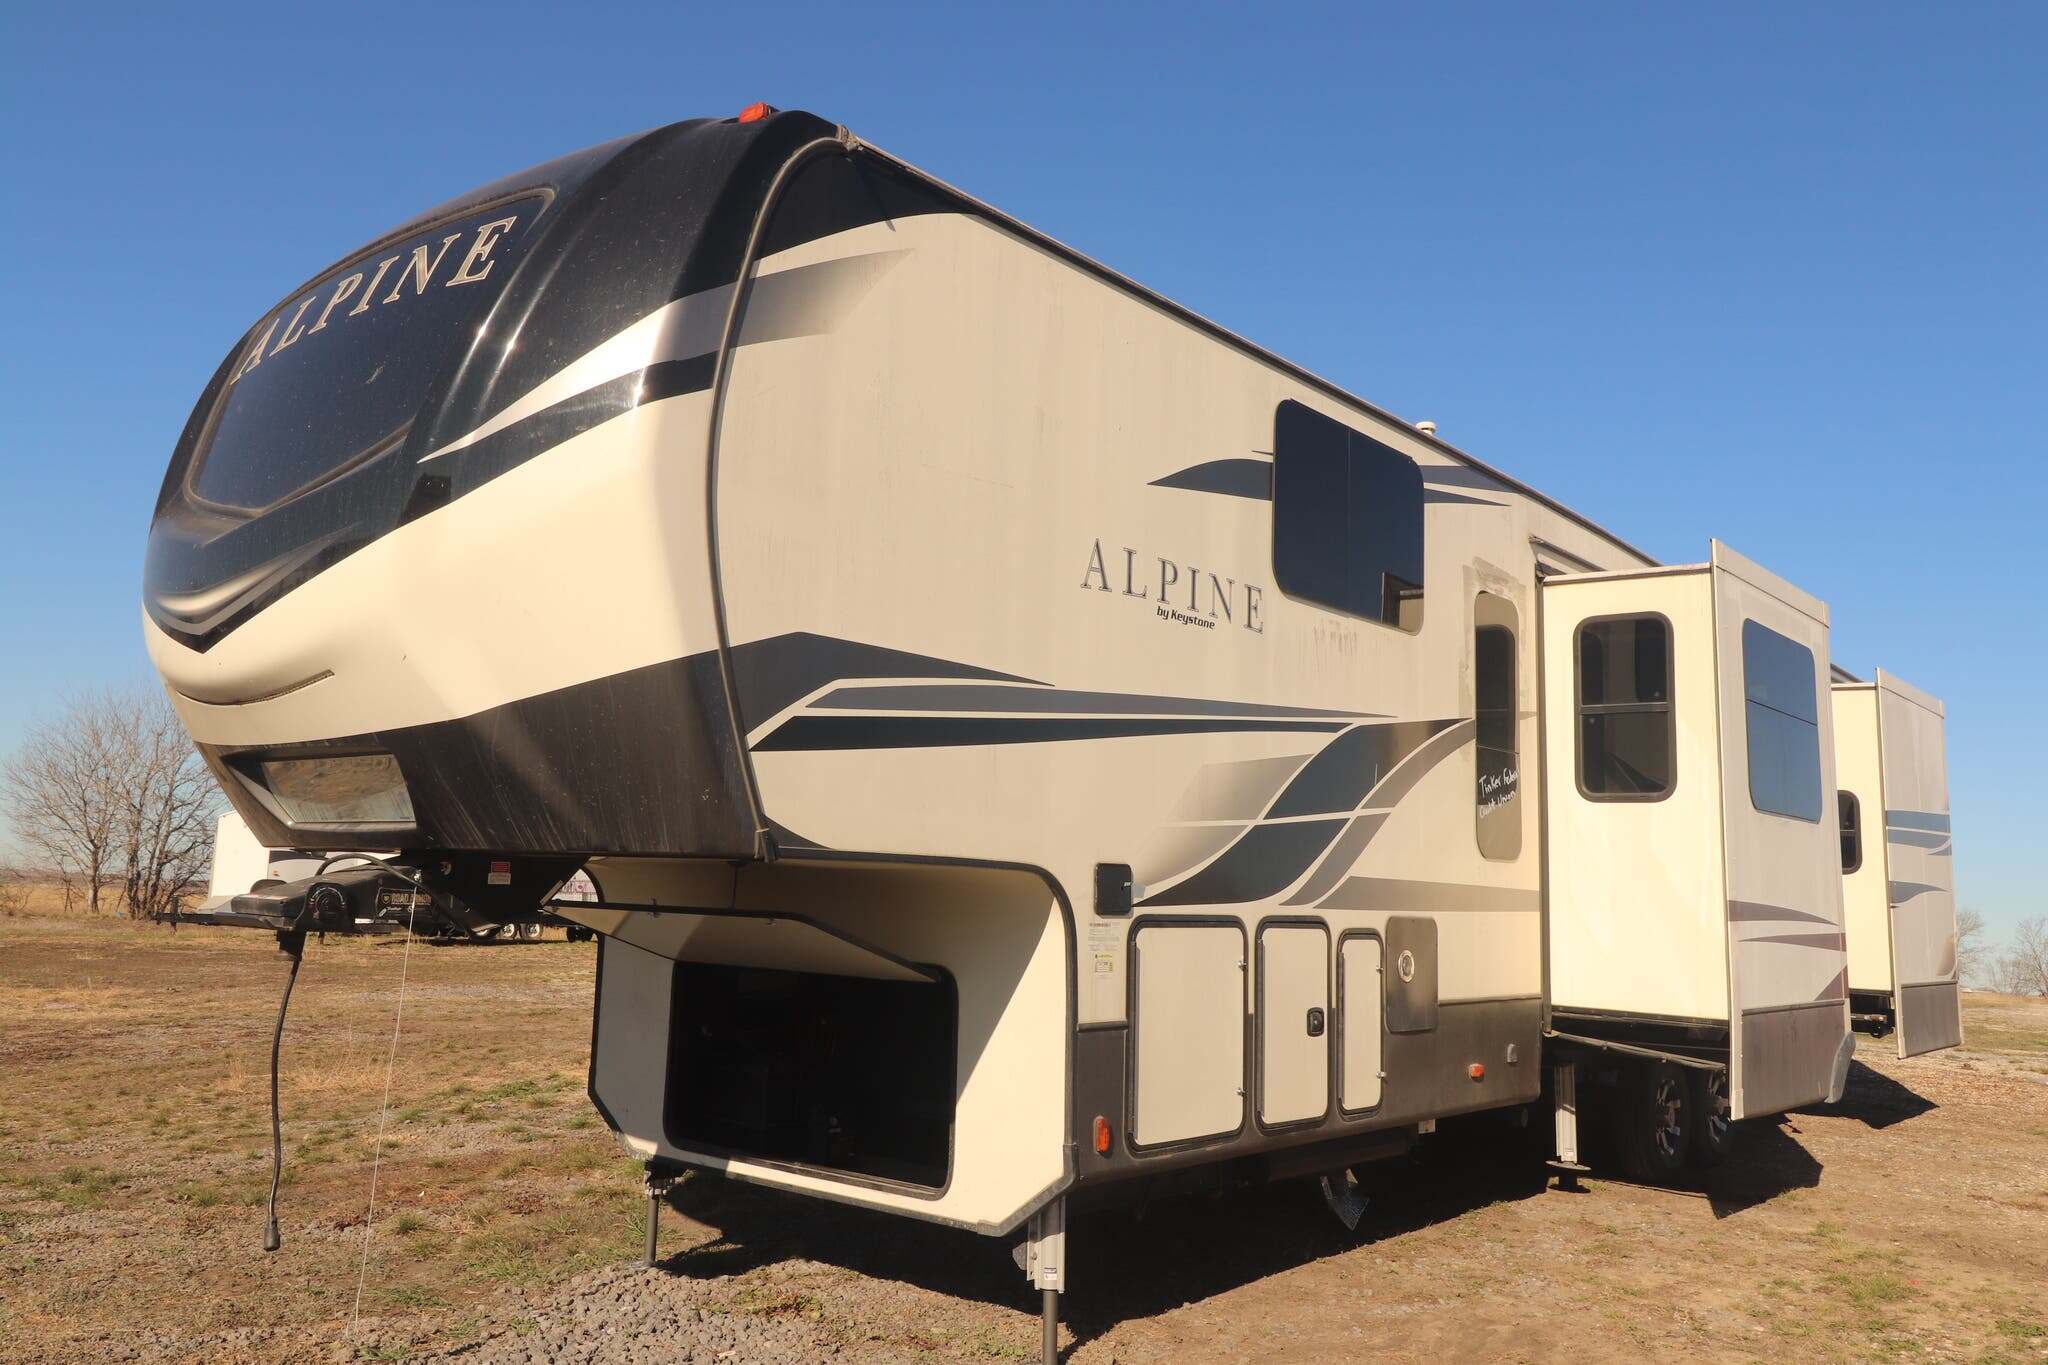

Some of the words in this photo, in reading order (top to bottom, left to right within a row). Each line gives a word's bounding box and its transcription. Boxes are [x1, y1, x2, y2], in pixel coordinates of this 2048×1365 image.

[230, 215, 518, 385] ALPINE
[1080, 537, 1266, 635] ALPINE
[1157, 606, 1169, 620] by
[1171, 609, 1215, 629] Keystone
[1479, 774, 1501, 798] Tinker
